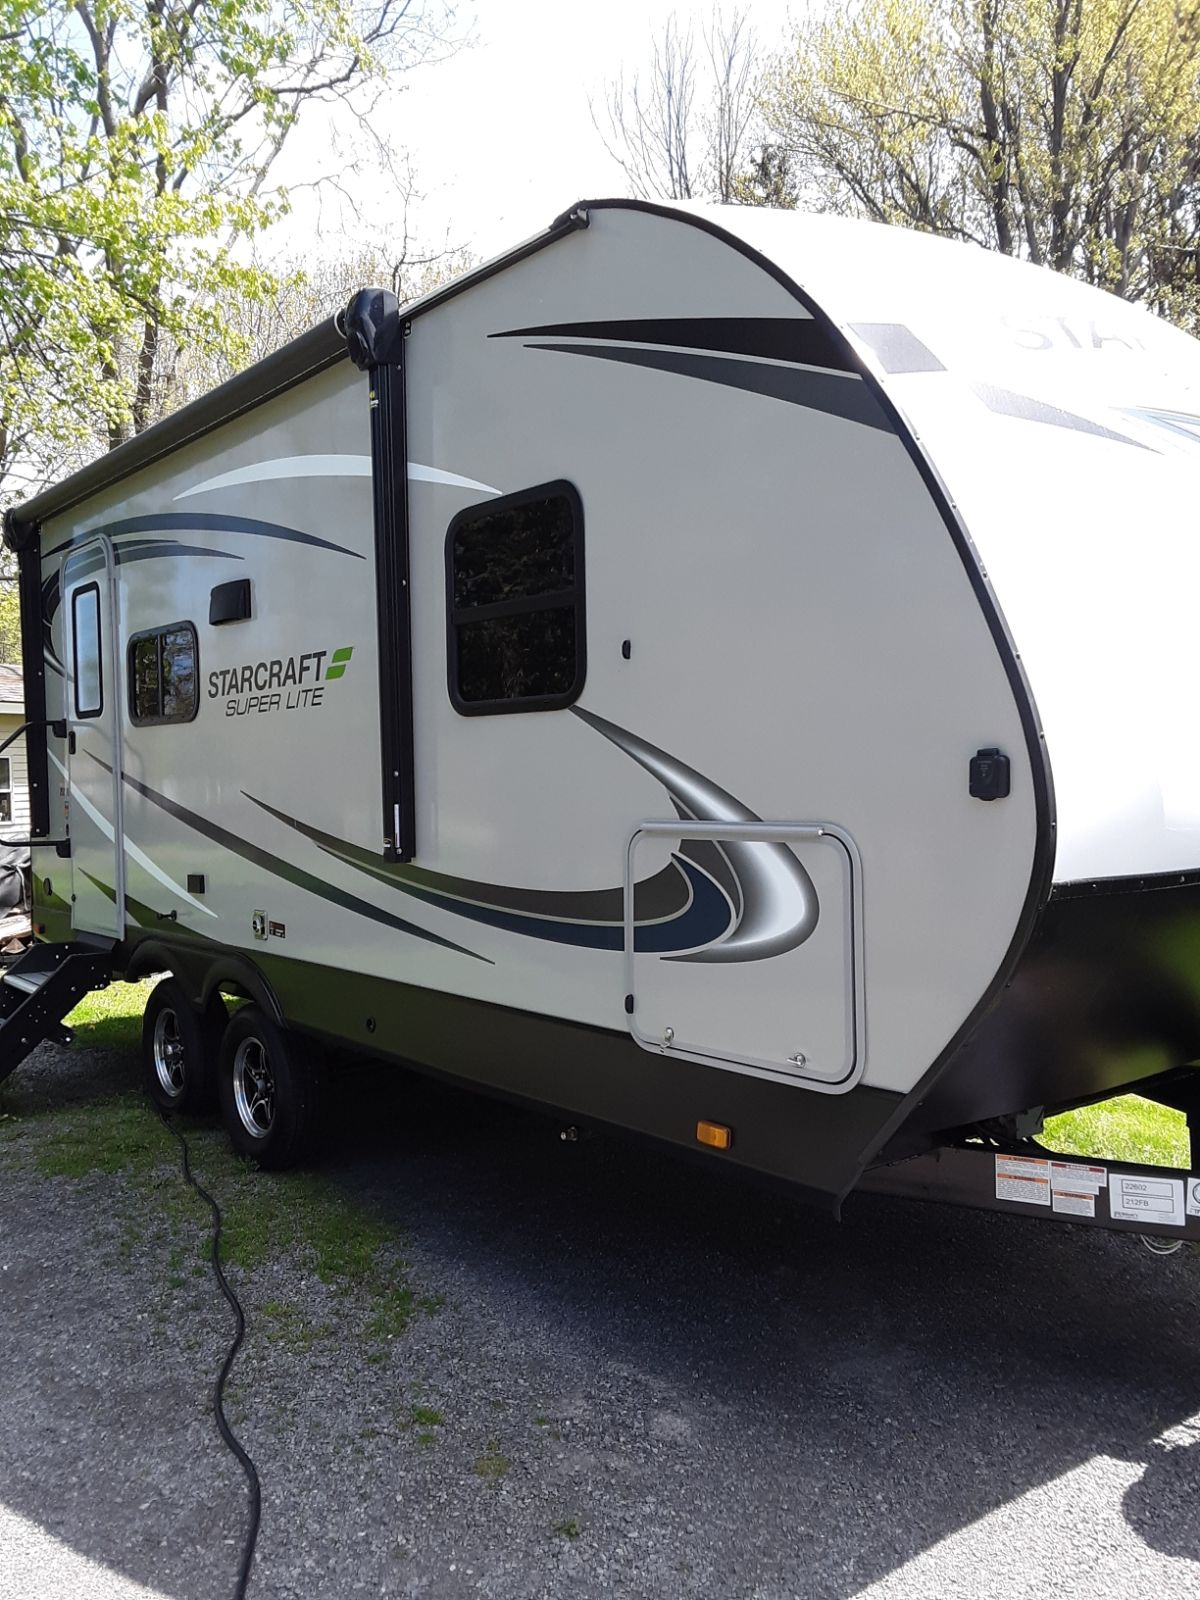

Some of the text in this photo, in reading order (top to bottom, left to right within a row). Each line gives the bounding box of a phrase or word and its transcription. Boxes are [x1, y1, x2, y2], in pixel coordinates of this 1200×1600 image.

[208, 650, 327, 698] STARCRAFT
[225, 687, 325, 717] SUPER LITE
